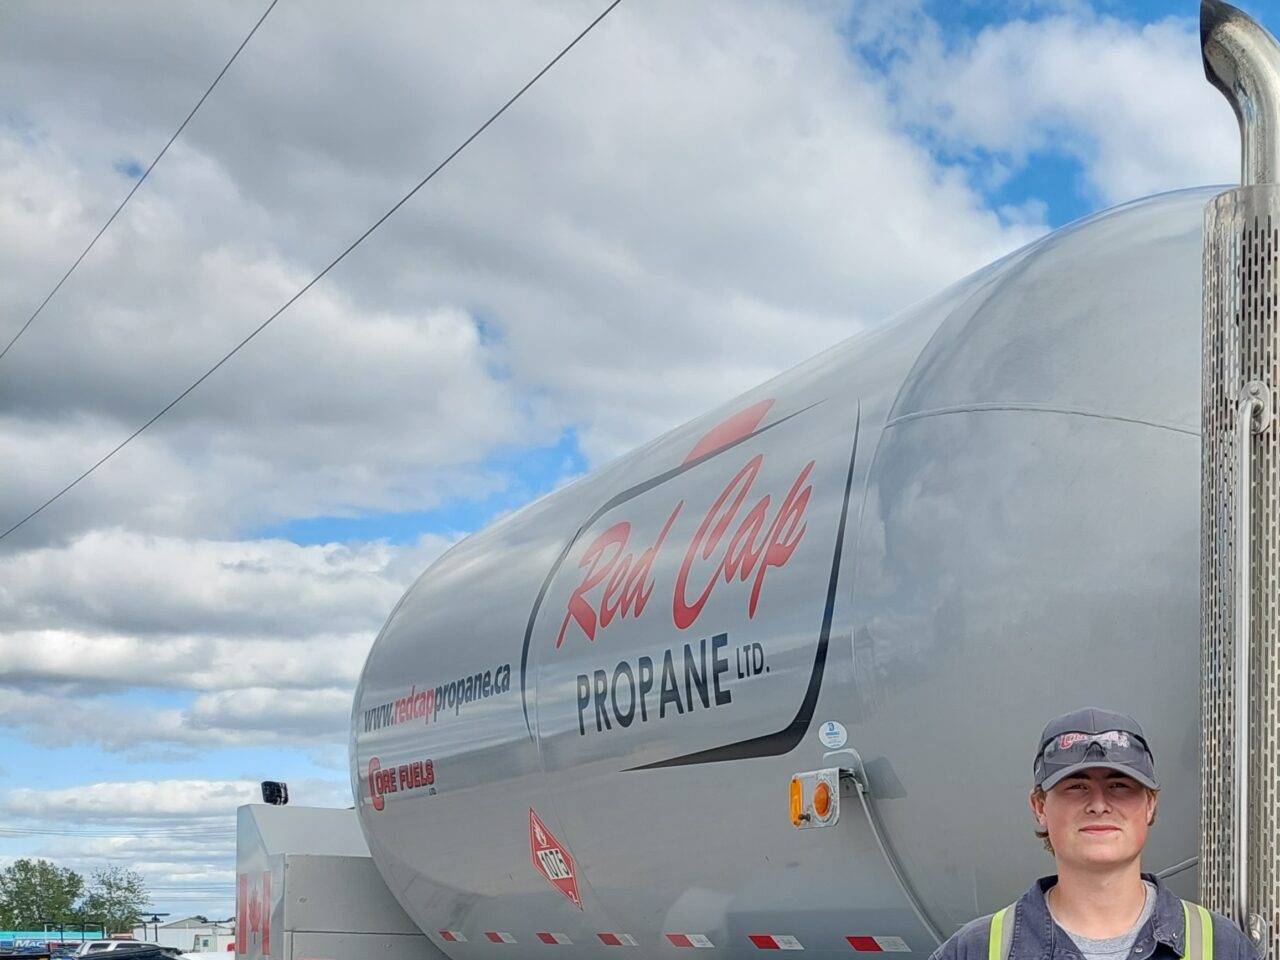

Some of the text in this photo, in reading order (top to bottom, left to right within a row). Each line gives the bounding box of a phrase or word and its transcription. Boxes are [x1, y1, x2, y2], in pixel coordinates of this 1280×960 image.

[556, 454, 816, 649] Red Cap
[364, 664, 511, 732] www.redcappropane.ca
[576, 632, 770, 736] PROPANE LTD.
[400, 759, 435, 791] FUELS
[541, 849, 570, 877] 1075
